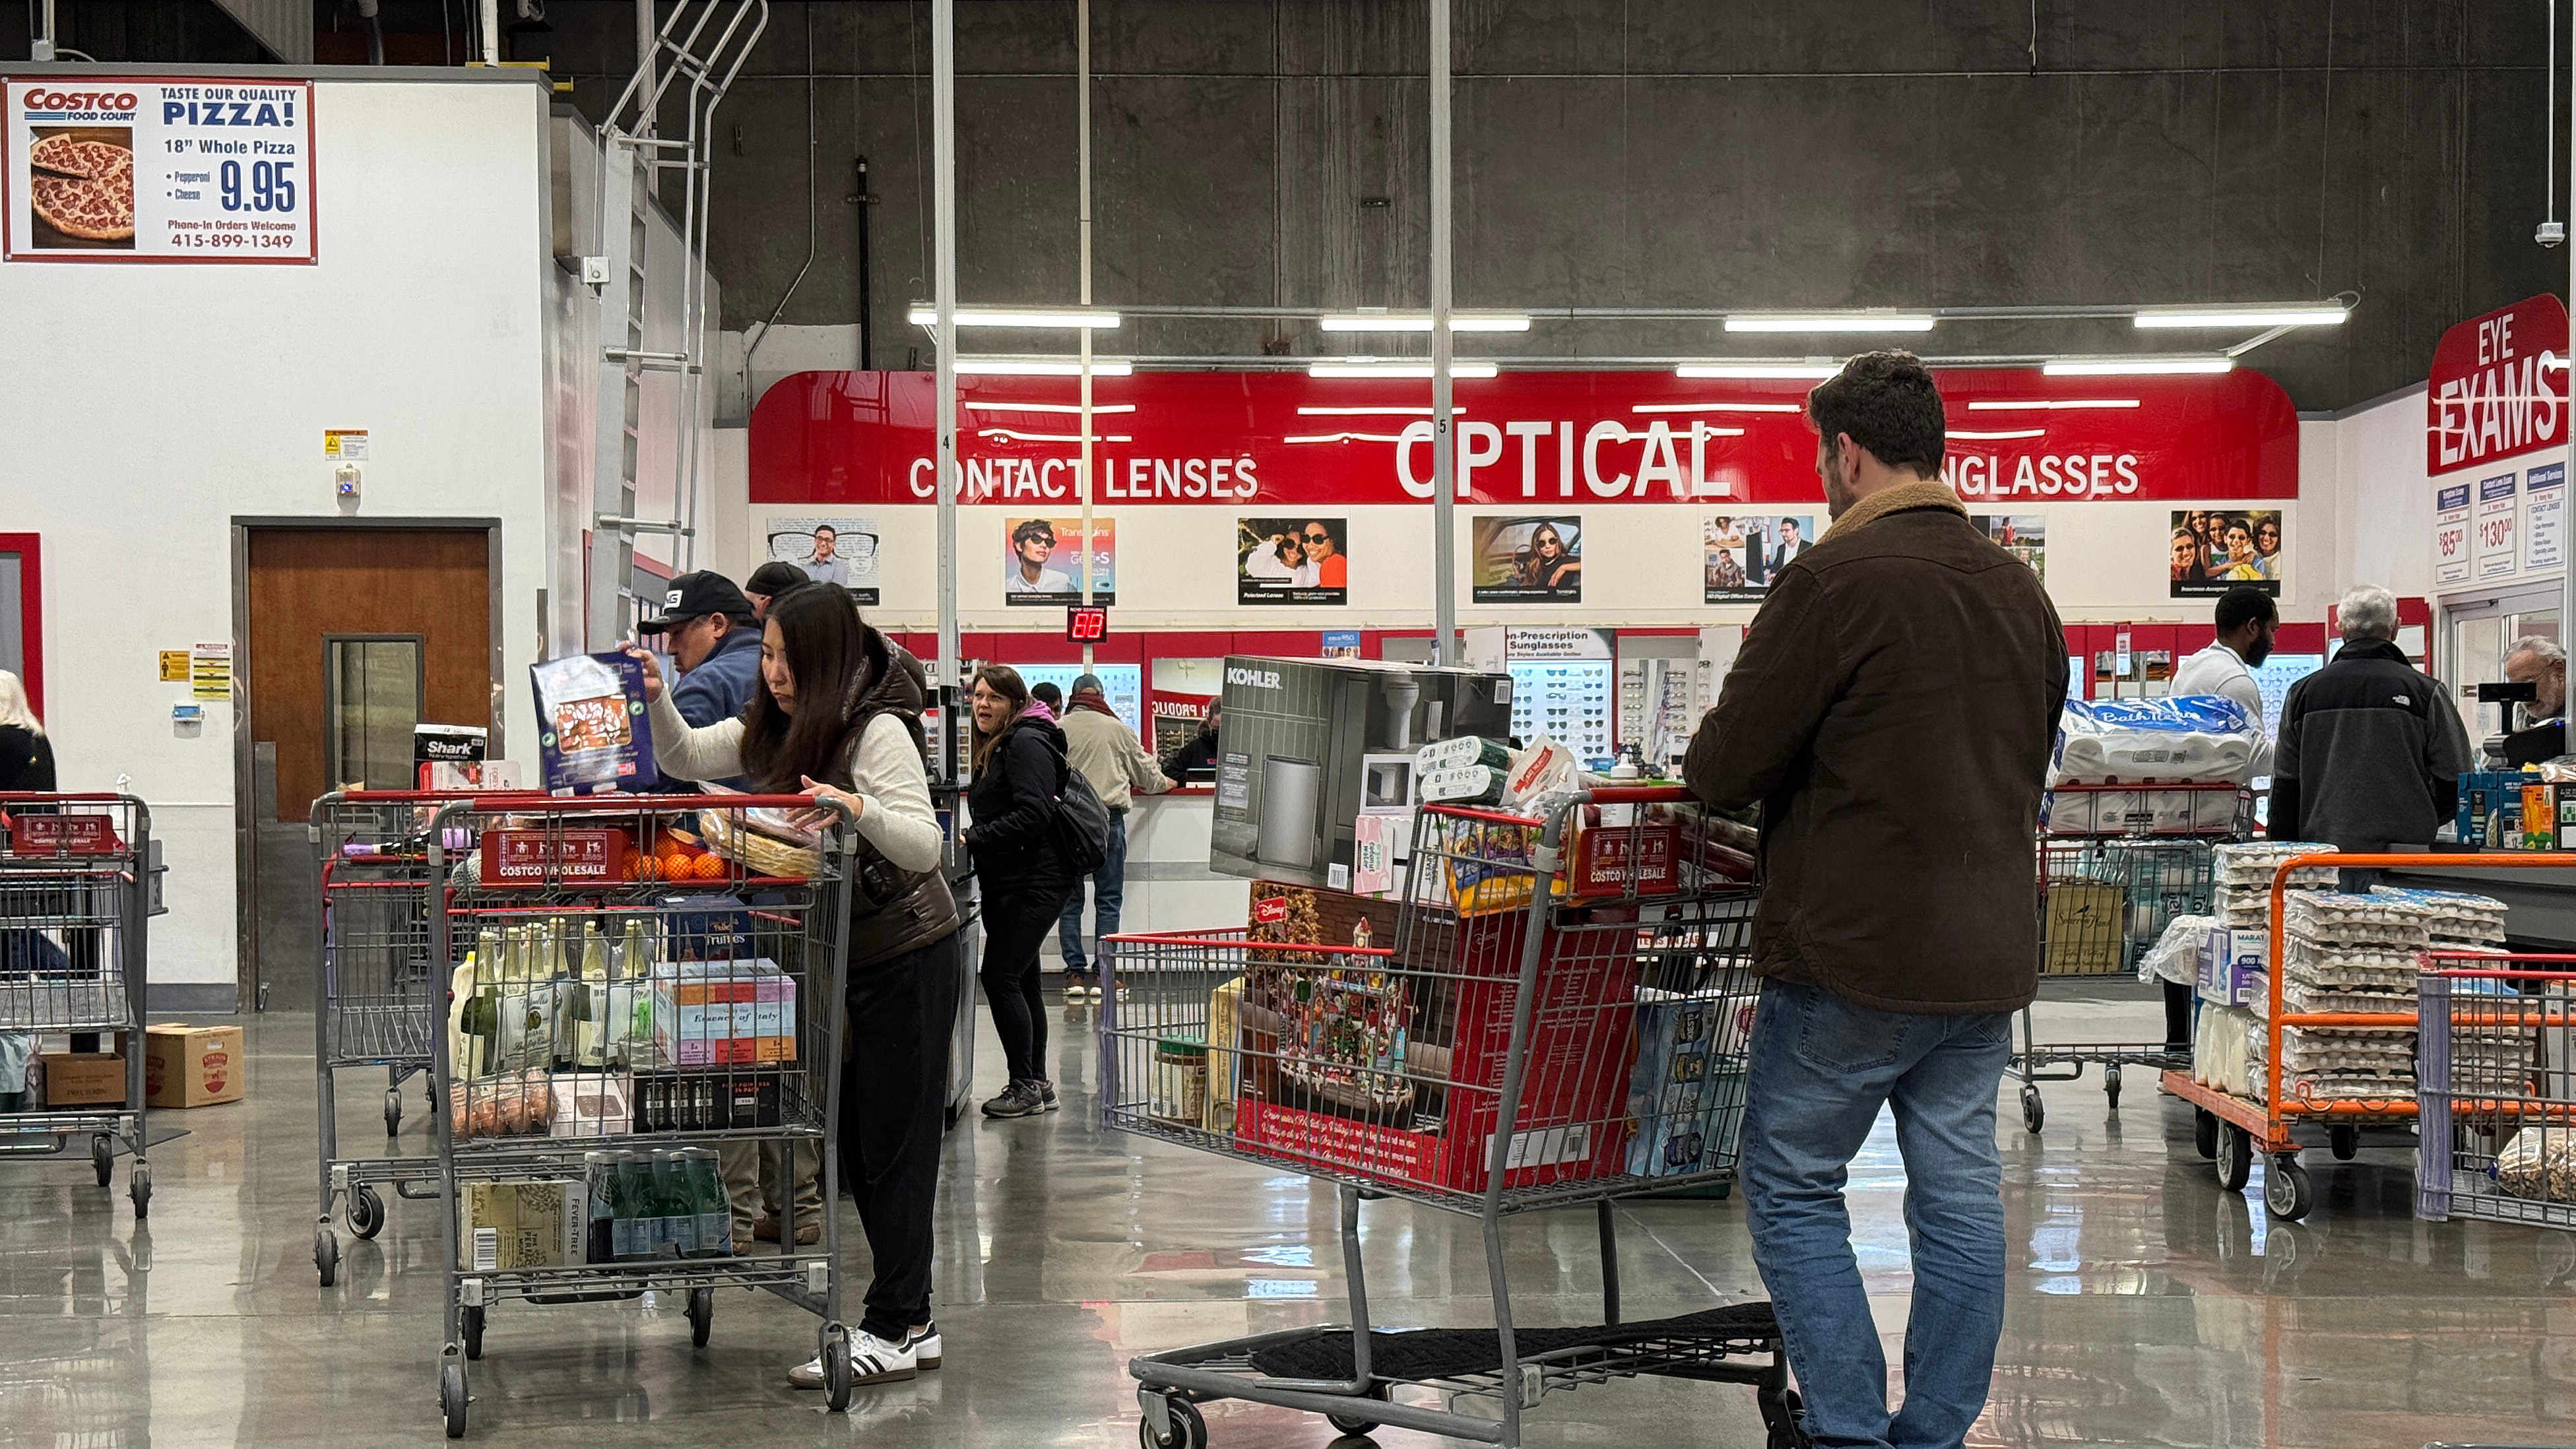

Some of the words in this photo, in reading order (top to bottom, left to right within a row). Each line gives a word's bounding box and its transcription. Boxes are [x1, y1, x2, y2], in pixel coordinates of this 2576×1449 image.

[23, 88, 138, 111] COSTCO
[160, 88, 199, 100] TASTE
[205, 88, 234, 100] OUR
[239, 89, 296, 102] QUALITY
[67, 112, 98, 121] FOOD
[100, 112, 137, 121] COURT
[163, 102, 294, 127] PIZZA!
[199, 139, 247, 154] Whole
[253, 141, 296, 155] Pizza
[174, 171, 210, 183] Pepperoni
[220, 160, 296, 212] 9.95
[175, 189, 201, 200] Cheese
[168, 220, 212, 230] Phone-In
[215, 220, 248, 231] Orders
[251, 221, 296, 232] Welcome
[171, 234, 294, 249] 415-899-1349
[2478, 313, 2514, 367] EYE
[2439, 350, 2558, 467] EXAMS
[1439, 419, 1447, 434] 5
[1395, 420, 1731, 499] OPTICAL
[1105, 457, 1258, 499] LENSES
[1941, 453, 2139, 496] NGLASSES
[1509, 641, 1574, 651] Sunglasses
[2102, 711, 2146, 723] Bath
[427, 740, 473, 756] Shark
[499, 866, 542, 876] COSTCO
[1590, 870, 1621, 883] COSTCO
[1261, 903, 1285, 917] Disney
[738, 1012, 751, 1023] of
[570, 1198, 580, 1256] FEVER-TREE
